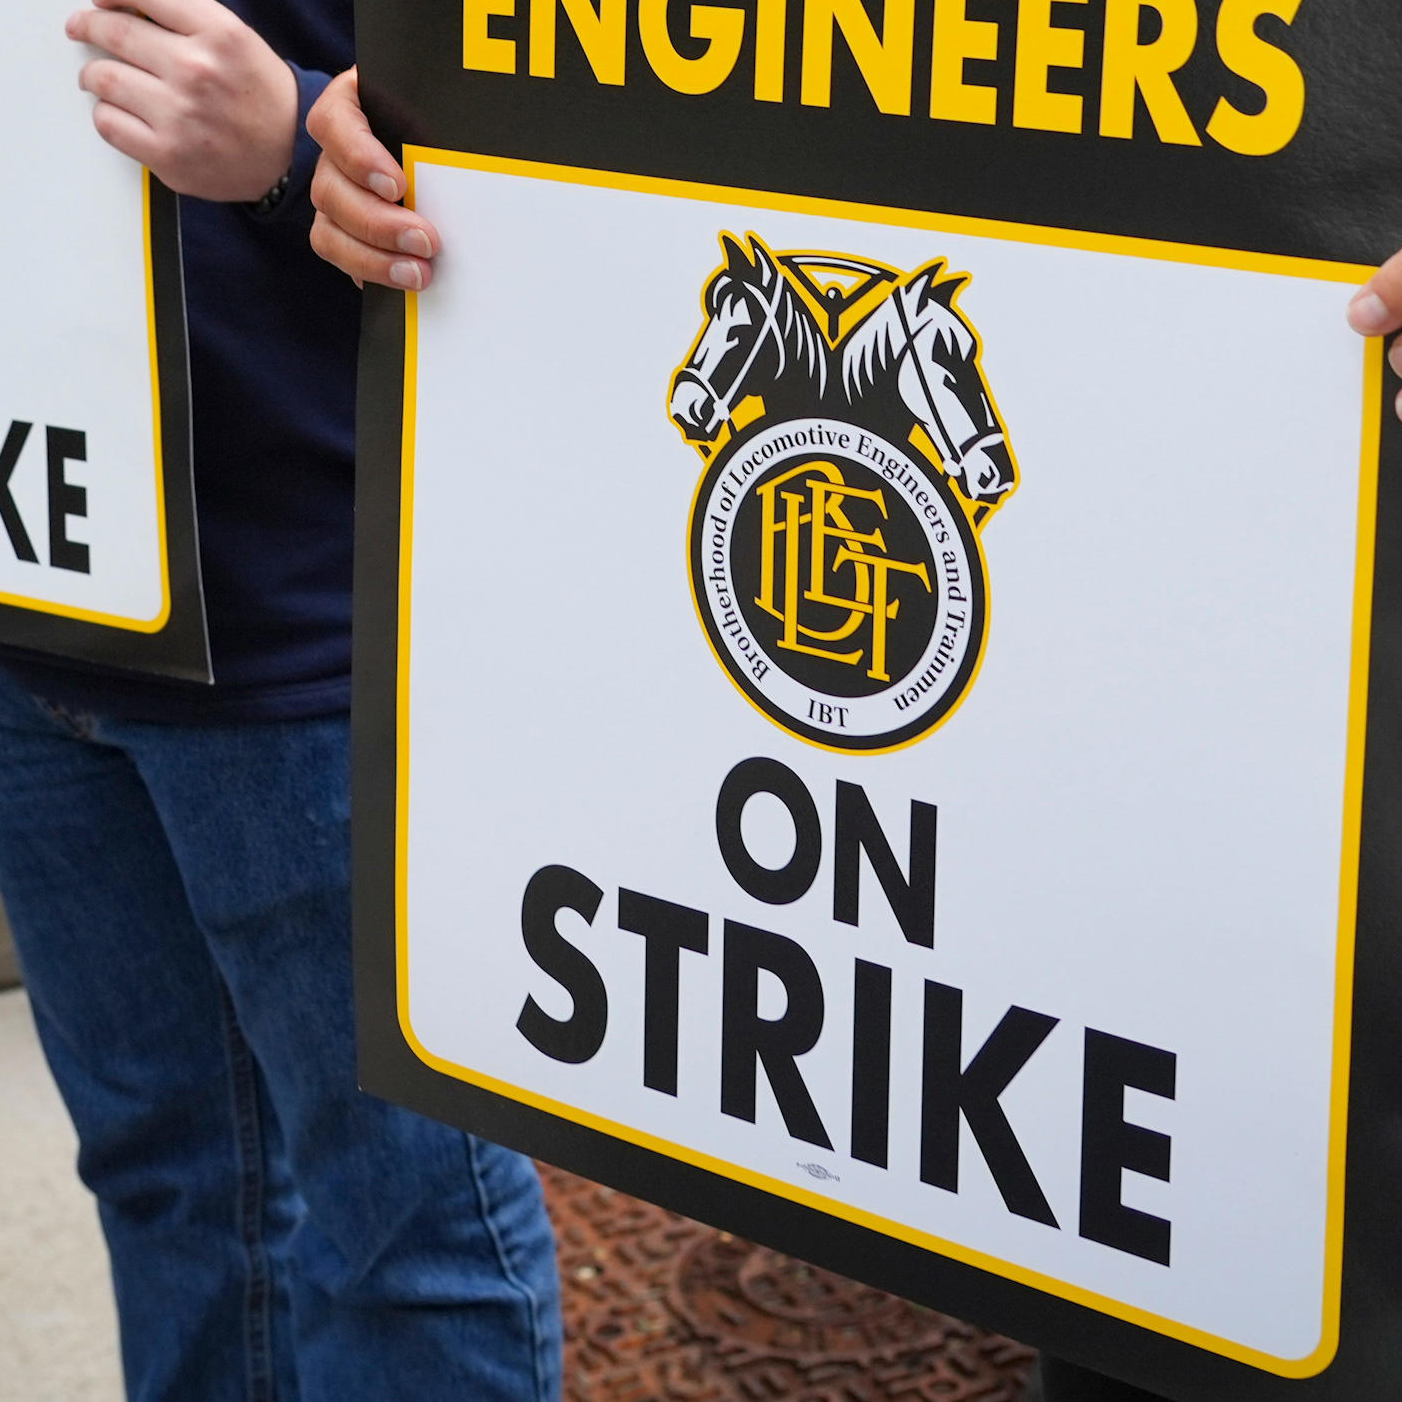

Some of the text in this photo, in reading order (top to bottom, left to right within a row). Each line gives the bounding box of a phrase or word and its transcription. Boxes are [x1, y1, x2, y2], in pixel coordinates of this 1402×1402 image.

[709, 424, 968, 713] Brotherhood of Locomotive Engineers and Trainmen
[805, 698, 850, 728] IBT
[715, 756, 938, 950] ON
[515, 864, 1177, 1268] STRIKE
